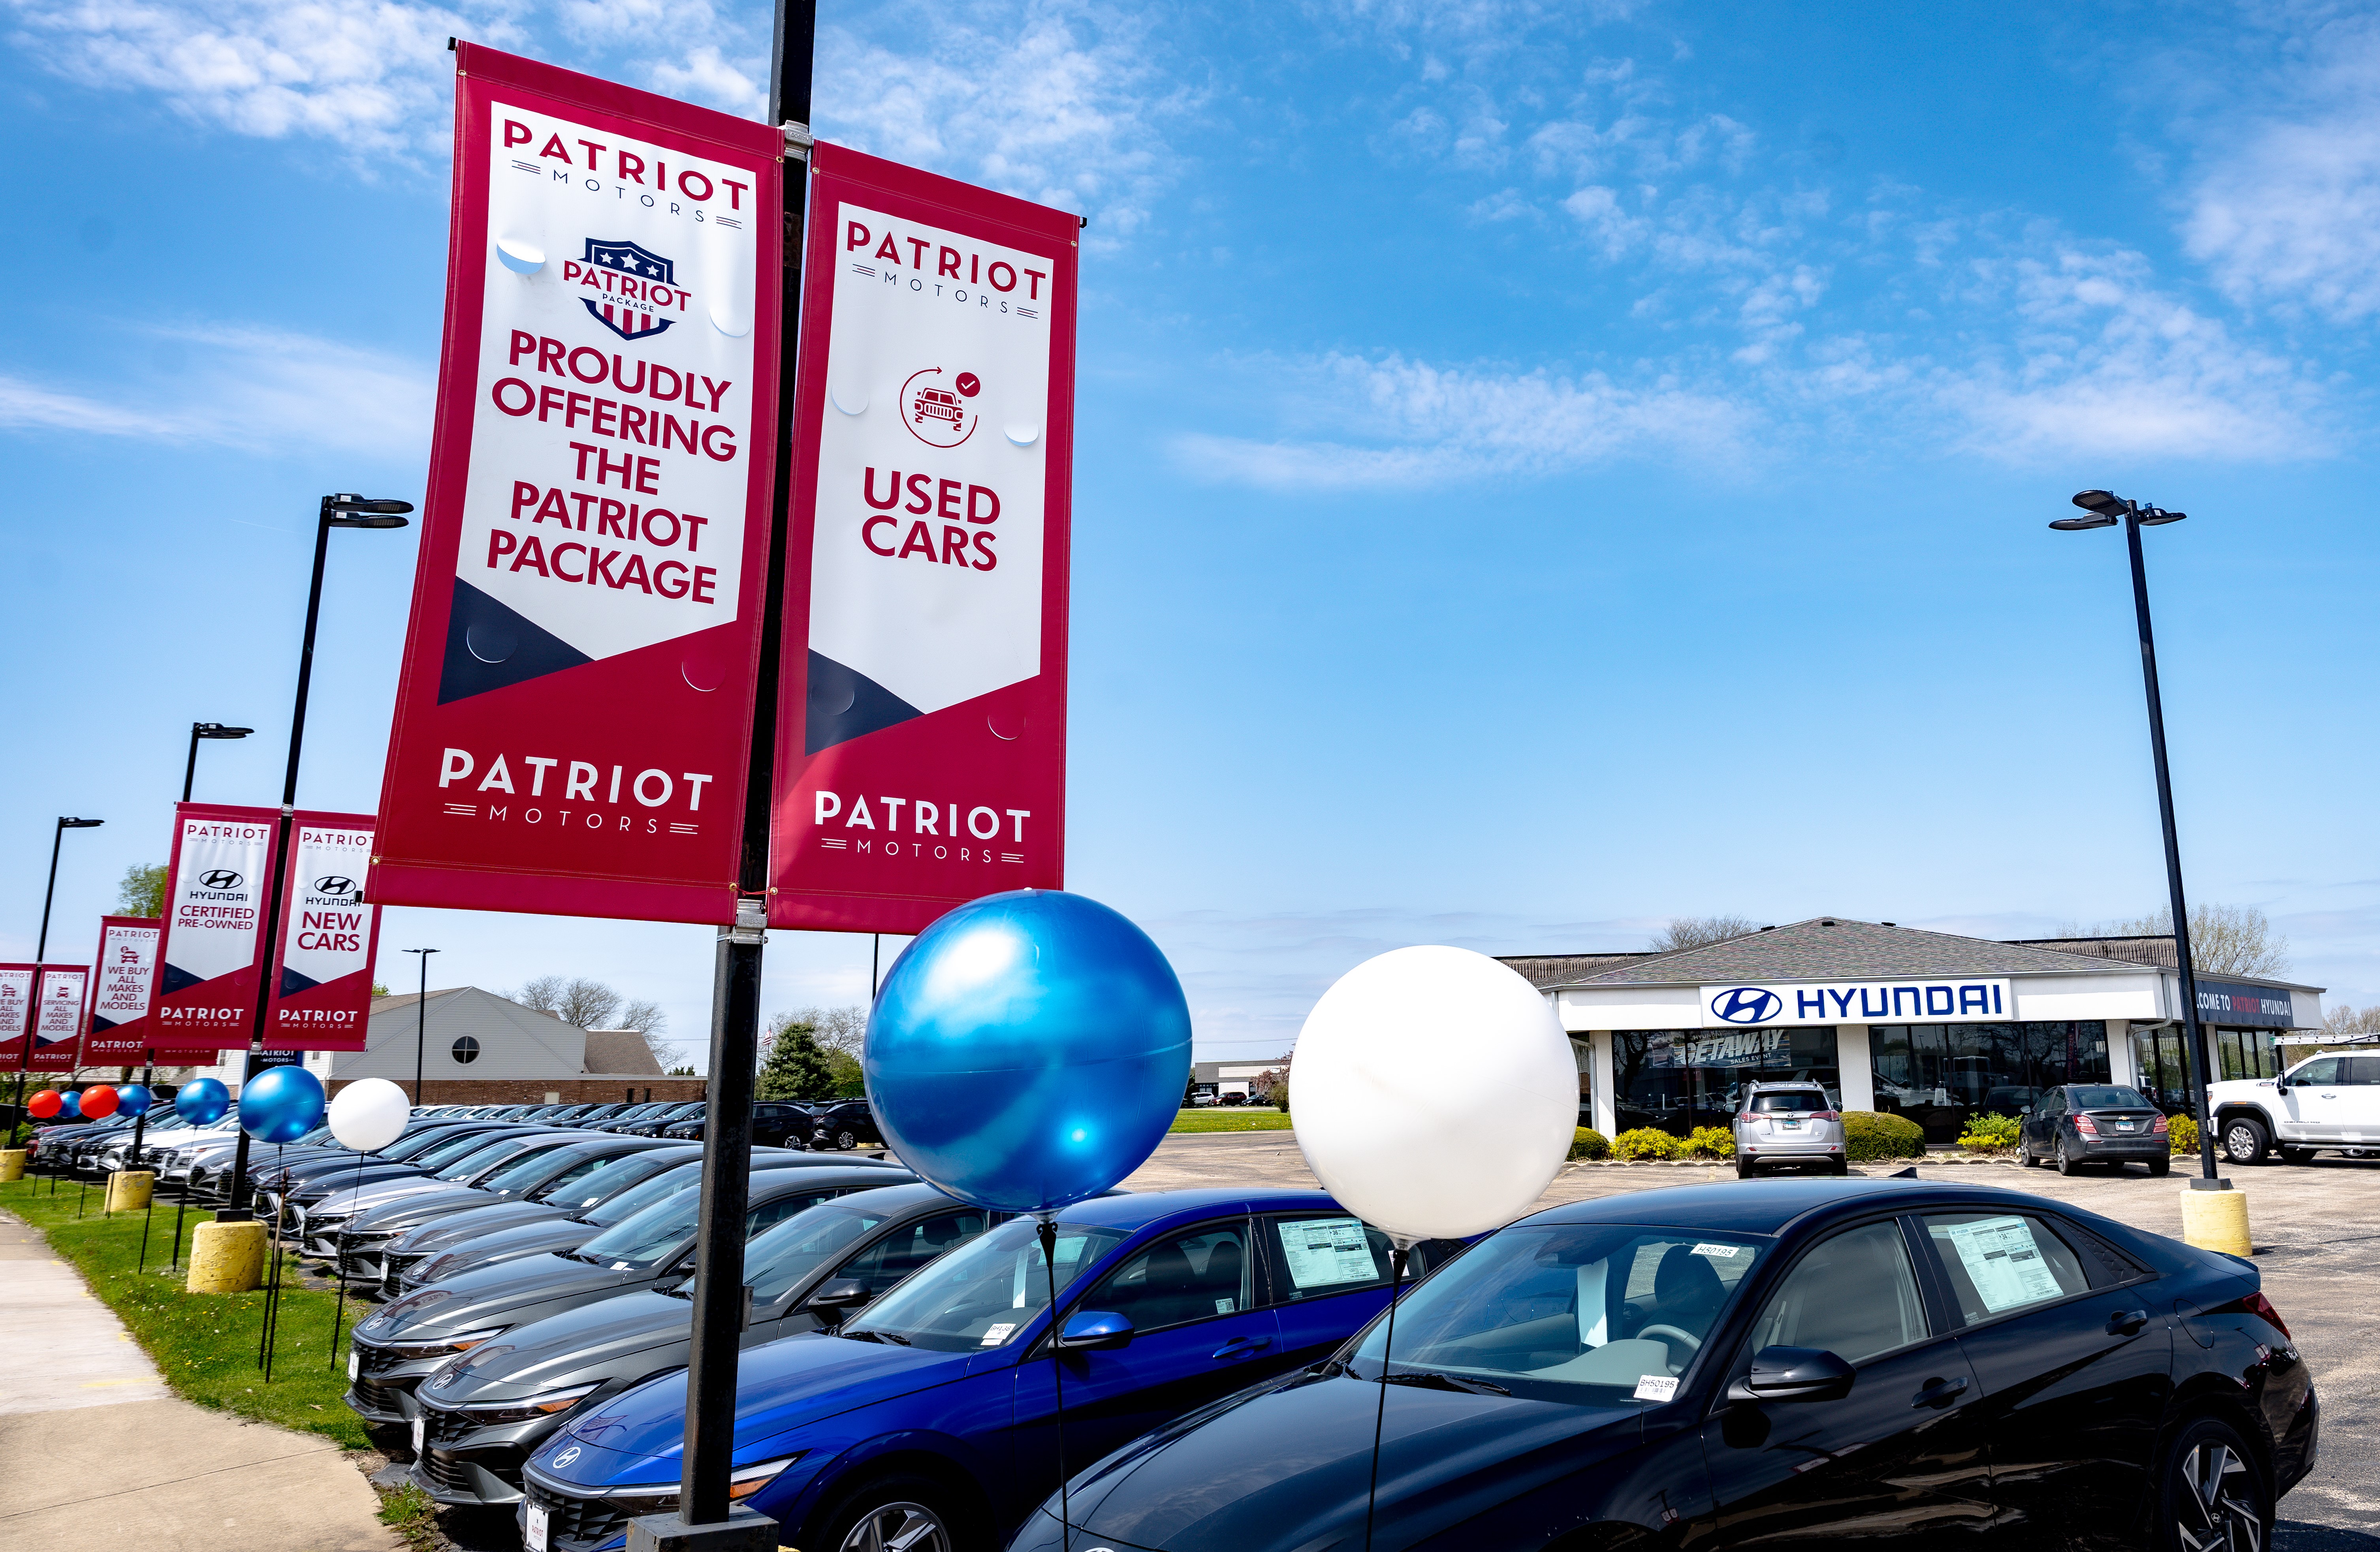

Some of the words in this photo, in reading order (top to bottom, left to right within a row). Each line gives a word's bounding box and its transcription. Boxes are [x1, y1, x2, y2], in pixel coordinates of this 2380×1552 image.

[504, 119, 748, 210] PATRIOT
[553, 169, 704, 222] MOTORS
[846, 220, 1046, 300] PATRIOT
[563, 260, 692, 312] PATRIOT
[885, 271, 1008, 314] MOTORS
[602, 293, 655, 312] PACKAGE
[509, 329, 733, 413] PROUDLY
[492, 377, 737, 462] OFFERING
[569, 441, 660, 496] THE
[864, 467, 1001, 525] USED
[510, 480, 708, 552] PATRIOT
[862, 515, 997, 572] CARS
[487, 529, 717, 605] PACKAGE
[438, 747, 713, 811] PATRIOT
[187, 824, 267, 839] PATRIOT
[489, 804, 657, 834] MOTORS
[815, 790, 1031, 843] PATRIOT
[303, 832, 374, 846] PATRIO
[857, 839, 991, 863] MOTORS
[190, 891, 248, 901] HYUNDAI
[178, 918, 253, 930] PRE-OWNED
[180, 905, 254, 919] CERTIFIED
[302, 911, 362, 930] NEW
[108, 929, 158, 939] PATRIOT
[298, 933, 360, 952] CARS
[107, 984, 144, 992] MAKES
[1797, 984, 2002, 1018] HYUNDAI
[100, 1001, 146, 1010] MODELS
[160, 1007, 244, 1020] PATRIOT
[279, 1009, 358, 1022] PATRIOT
[2220, 994, 2230, 1011] TO
[2232, 995, 2260, 1014] PATRIOT
[2260, 999, 2291, 1016] HYUNDAI
[1678, 1029, 1784, 1065] GETAWAY
[1696, 1246, 1733, 1256] H50195
